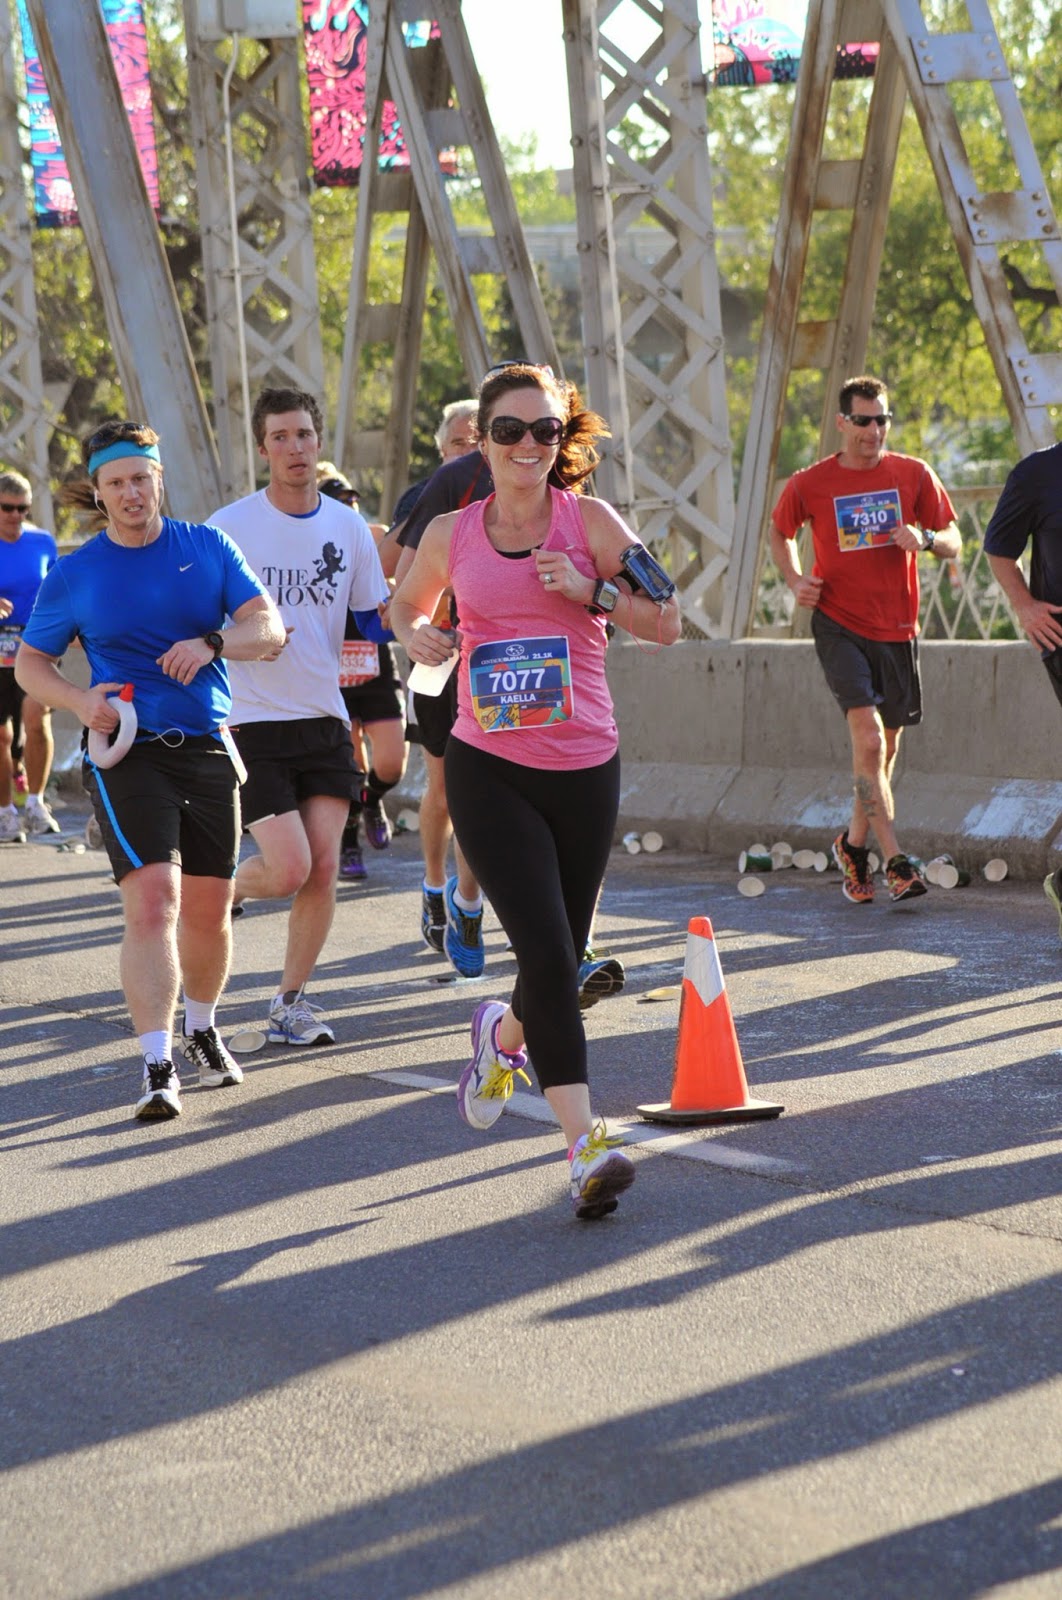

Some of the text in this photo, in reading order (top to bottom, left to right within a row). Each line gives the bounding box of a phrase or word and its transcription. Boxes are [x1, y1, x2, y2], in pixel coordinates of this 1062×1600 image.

[851, 510, 888, 527] 7310
[261, 566, 308, 585] THE
[275, 585, 337, 608] IONS
[488, 668, 546, 693] 7077
[500, 693, 537, 704] KAELLA
